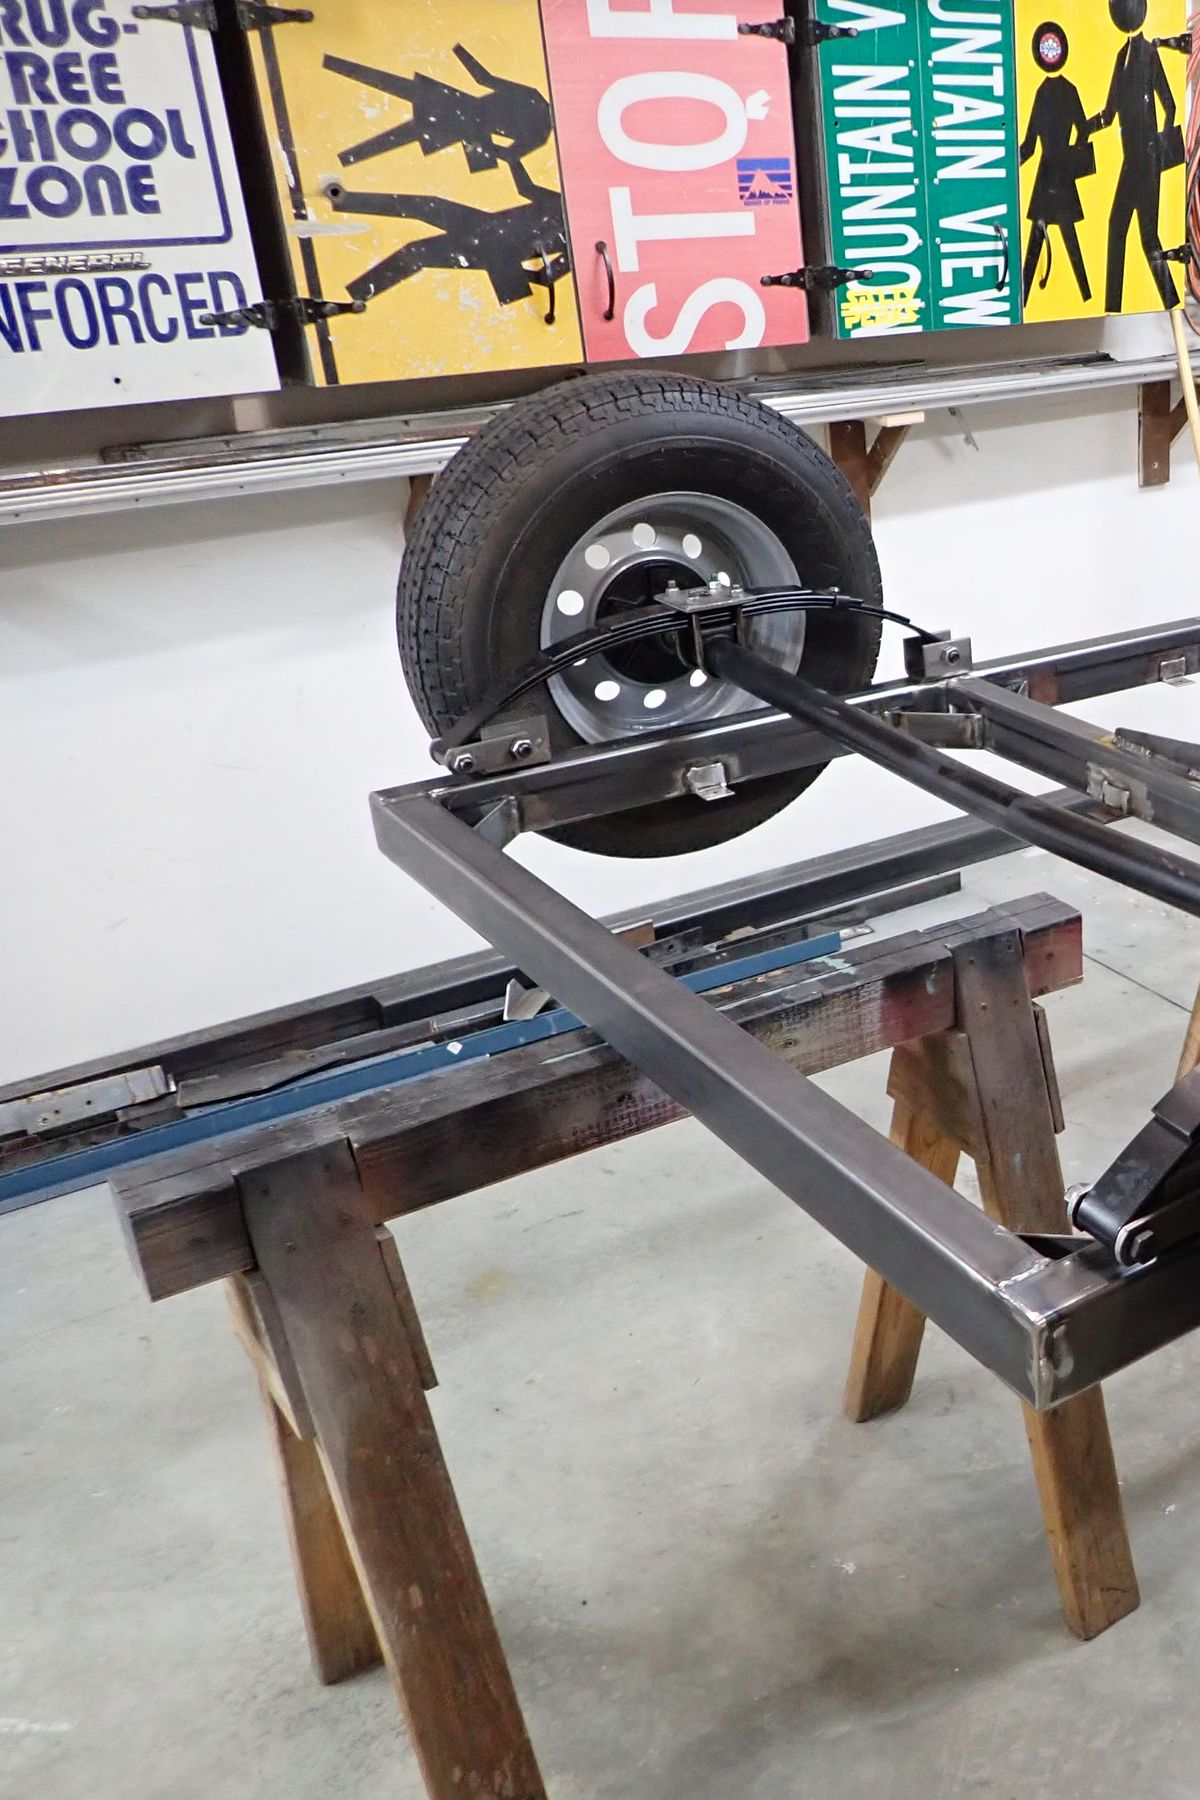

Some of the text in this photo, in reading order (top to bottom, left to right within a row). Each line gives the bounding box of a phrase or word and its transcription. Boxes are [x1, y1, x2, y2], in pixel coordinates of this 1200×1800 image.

[0, 107, 196, 162] HOOL
[832, 65, 923, 338] OUNTAIN
[939, 204, 1010, 325] VIEW
